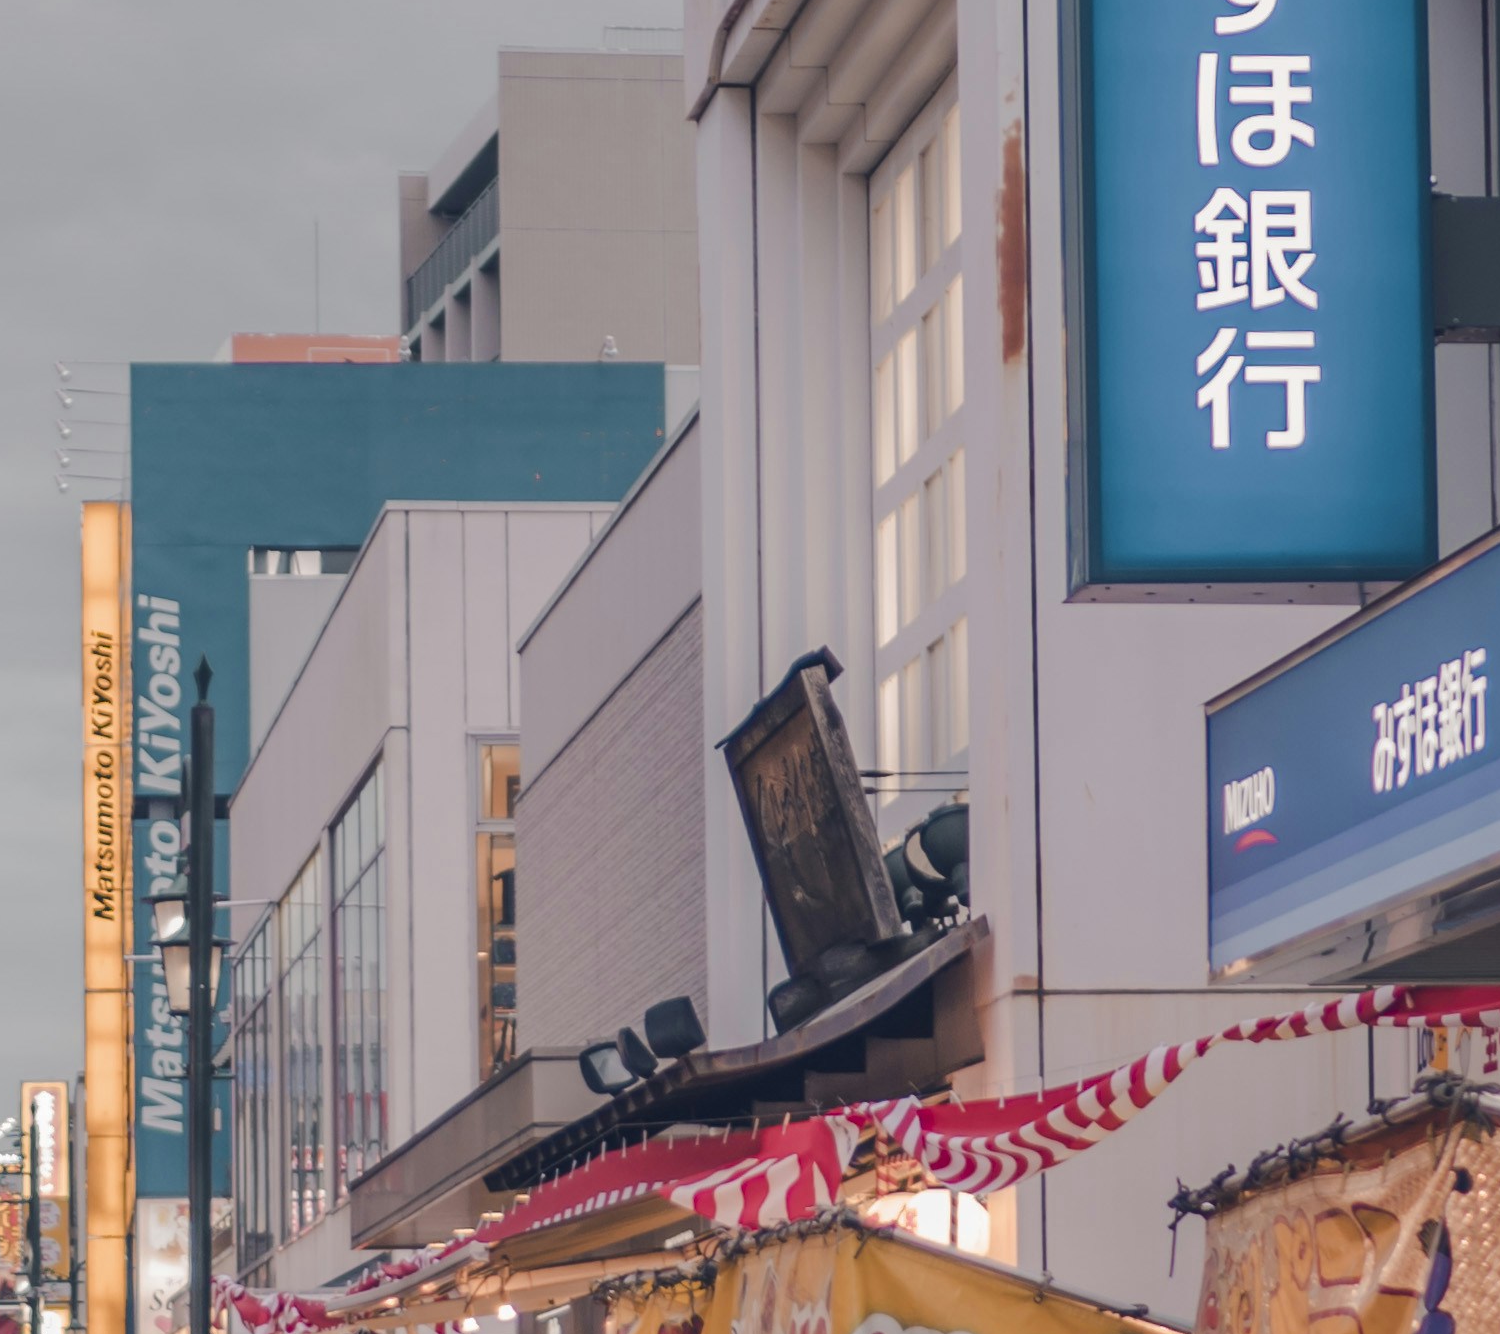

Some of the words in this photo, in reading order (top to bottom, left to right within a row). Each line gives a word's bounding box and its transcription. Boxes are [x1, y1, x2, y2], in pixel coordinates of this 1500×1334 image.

[91, 630, 114, 741] KiYoshi
[138, 593, 182, 795] KiYoshi
[1371, 646, 1488, 795] みずほ銀行
[93, 750, 116, 922] Matsumoto
[1222, 765, 1276, 836] MIZUHO
